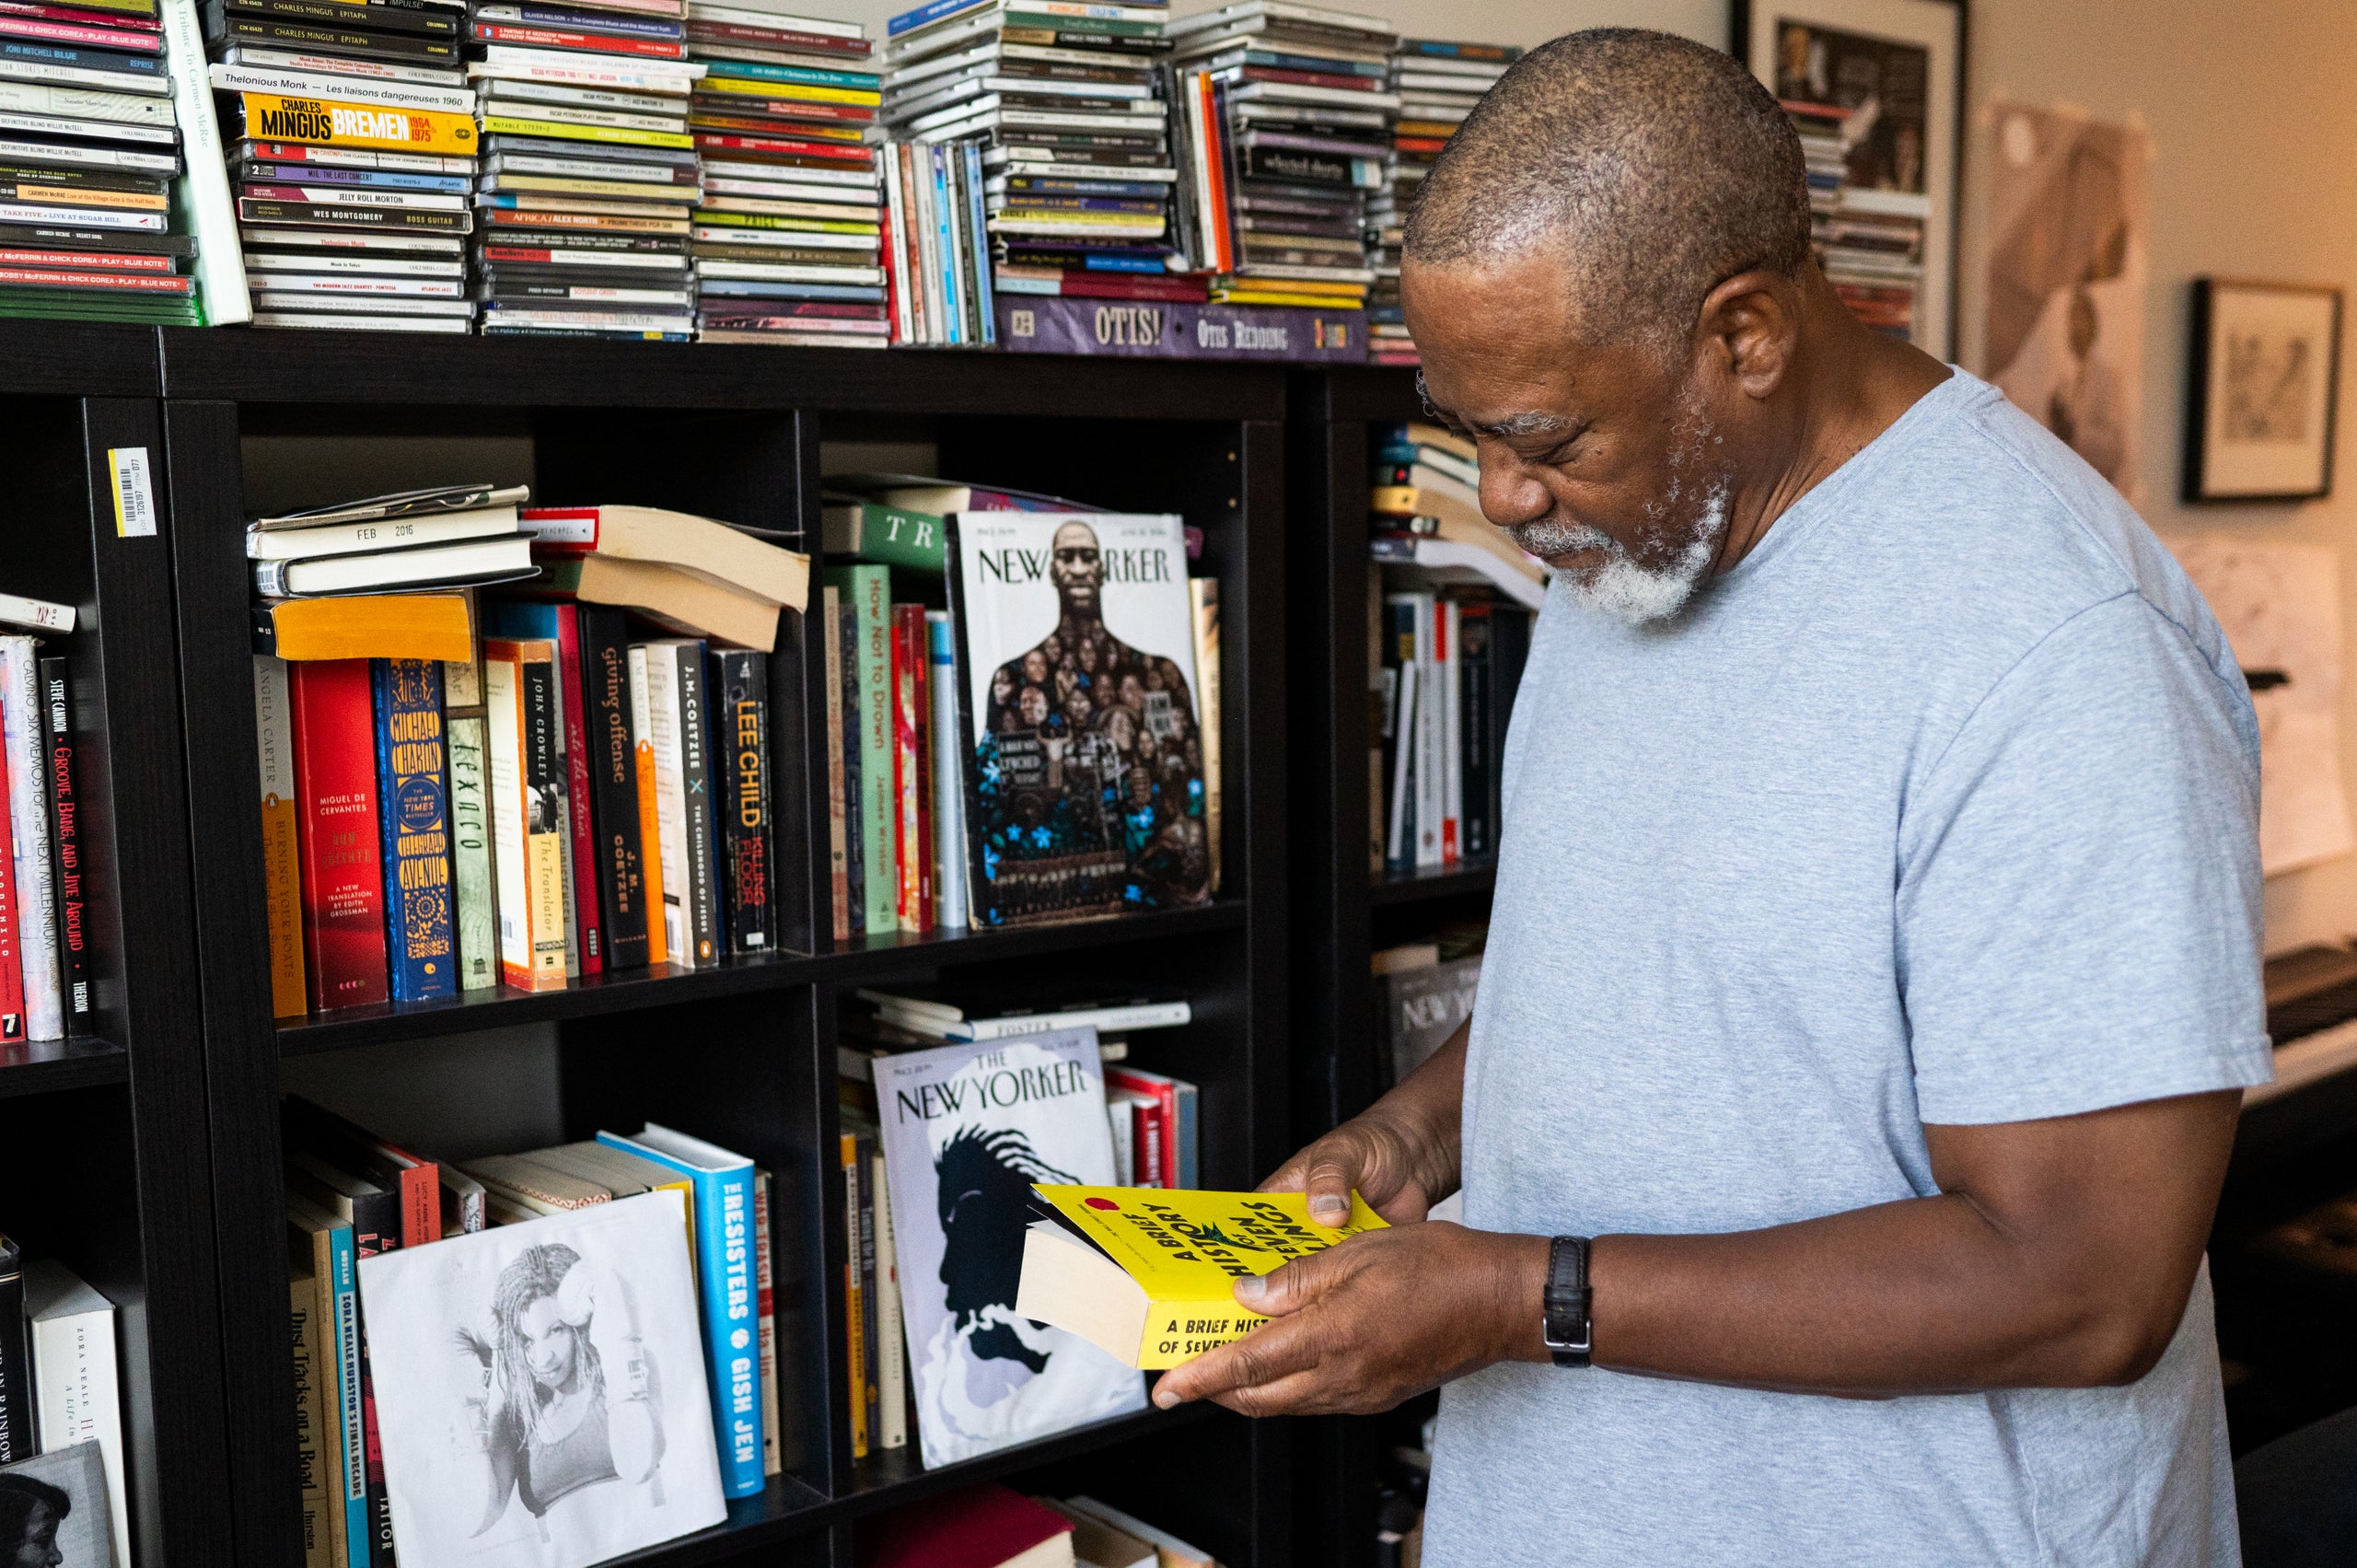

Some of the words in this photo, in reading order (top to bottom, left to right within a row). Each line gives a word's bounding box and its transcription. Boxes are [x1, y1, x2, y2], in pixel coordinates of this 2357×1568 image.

[273, 3, 305, 13] CHARLES
[306, 6, 333, 17] MINGUS
[545, 13, 566, 21] NELSON
[582, 17, 605, 26] Complete
[35, 27, 58, 37] CHICK
[110, 35, 130, 45] BLUE
[179, 9, 191, 45] Tribute
[274, 28, 306, 39] CHARLES
[307, 31, 335, 42] MINGUS
[341, 36, 368, 45] EPITAPH
[6, 45, 21, 53] JONI
[22, 47, 52, 58] MITCHELL
[53, 51, 77, 61] BLUE
[130, 59, 155, 70] REPRISE
[185, 52, 196, 65] To
[427, 46, 449, 54] COLUMBIA
[44, 67, 75, 77] MITCHELL
[189, 68, 201, 110] Carmen
[225, 73, 278, 87] Thelonious
[281, 77, 308, 90] Monk
[344, 86, 379, 99] liaisons
[381, 89, 440, 107] dangereuses
[443, 97, 463, 107] 1960
[281, 99, 321, 113] CHARLES
[196, 113, 210, 148] McRae
[261, 109, 331, 140] MINGUS
[331, 109, 410, 141] BREMEN
[409, 116, 430, 129] 1964
[411, 129, 432, 143] 1975
[30, 145, 46, 154] BLIND
[251, 166, 260, 176] 2
[348, 172, 373, 182] CONCERT
[339, 193, 355, 202] JELLY
[374, 195, 403, 203] MORTON
[78, 214, 103, 222] SUGAR
[104, 215, 122, 224] HILL
[313, 210, 330, 218] WES
[331, 211, 383, 222] MONTGOMERY
[427, 216, 453, 226] GUITAR
[552, 215, 572, 224] ALEX
[572, 216, 598, 226] NORTH
[49, 254, 72, 262] CHICK
[73, 255, 98, 263] COREA
[101, 257, 121, 265] PLAY
[124, 259, 142, 267] BLUE
[90, 276, 115, 285] COREA
[140, 279, 159, 287] BLUE
[1094, 306, 1164, 347] OTIS!
[357, 528, 377, 540] FEB
[395, 524, 413, 537] 2016
[978, 549, 1049, 584] NEW
[22, 659, 37, 708] CALVINO
[50, 679, 65, 703] STEVE
[601, 646, 624, 710] giving
[259, 665, 273, 723] ANGELA
[532, 677, 545, 714] JOHN
[27, 714, 41, 734] SIX
[52, 702, 68, 733] CANNON
[737, 701, 758, 748] LEE
[29, 738, 44, 787] MEMOS
[263, 727, 276, 783] CARTER
[535, 718, 548, 779] CROWLEY
[610, 712, 629, 784] offense
[53, 747, 73, 800] GROOVE,
[32, 790, 44, 808] for
[319, 795, 351, 806] MIGUEL
[354, 793, 366, 802] DE
[738, 750, 761, 829] CHILD
[57, 802, 75, 842] BANG,
[319, 804, 366, 816] CERVANTES
[404, 801, 435, 813] TIMES
[694, 805, 703, 824] THE
[35, 836, 50, 866] NEXT
[276, 819, 290, 886] BURNING
[540, 839, 552, 863] The
[695, 827, 706, 886] CHILDHOOD
[64, 871, 80, 898] JIVE
[613, 834, 630, 914] COETZEE
[739, 839, 755, 906] FLOOR
[751, 835, 766, 907] KILLING
[328, 890, 373, 901] TRANSLATION
[343, 883, 359, 891] NEW
[541, 865, 555, 932] Translator
[699, 888, 708, 901] OF
[38, 871, 55, 952] MILLENNIUM
[279, 889, 290, 929] YOUR
[330, 907, 368, 918] GROSSMAN
[343, 900, 364, 908] EDITH
[700, 903, 710, 934] JESUS
[65, 900, 85, 952] AROUND
[73, 981, 89, 1014] THERION
[2, 1014, 16, 1034] 7
[976, 1051, 1007, 1070] THE
[896, 1078, 967, 1124] NEW
[971, 1059, 1087, 1109] YORKER
[723, 1182, 743, 1194] THE
[1120, 1212, 1186, 1249] BRIEF
[1140, 1202, 1259, 1277] HISTORY
[1230, 1233, 1256, 1246] OF
[340, 1249, 351, 1285] MOYLAN
[724, 1194, 749, 1320] RESISTERS
[1172, 1249, 1203, 1263] A
[343, 1295, 353, 1324] ZORA
[290, 1307, 308, 1350] Dust
[1166, 1318, 1178, 1333] A
[1185, 1318, 1231, 1334] BRIEF
[76, 1327, 86, 1359] ZORA
[344, 1325, 355, 1361] NEALE
[1158, 1341, 1179, 1354] OF
[80, 1366, 89, 1408] NEALE
[292, 1352, 312, 1407] Tracks
[346, 1362, 358, 1421] HURSTON'S
[730, 1356, 753, 1414] GISH
[66, 1398, 75, 1421] Life
[296, 1408, 310, 1427] on
[349, 1421, 359, 1454] FINAL
[734, 1419, 755, 1464] JEN
[299, 1449, 318, 1491] Road
[350, 1456, 362, 1497] DECADE
[303, 1509, 316, 1551] Hurston
